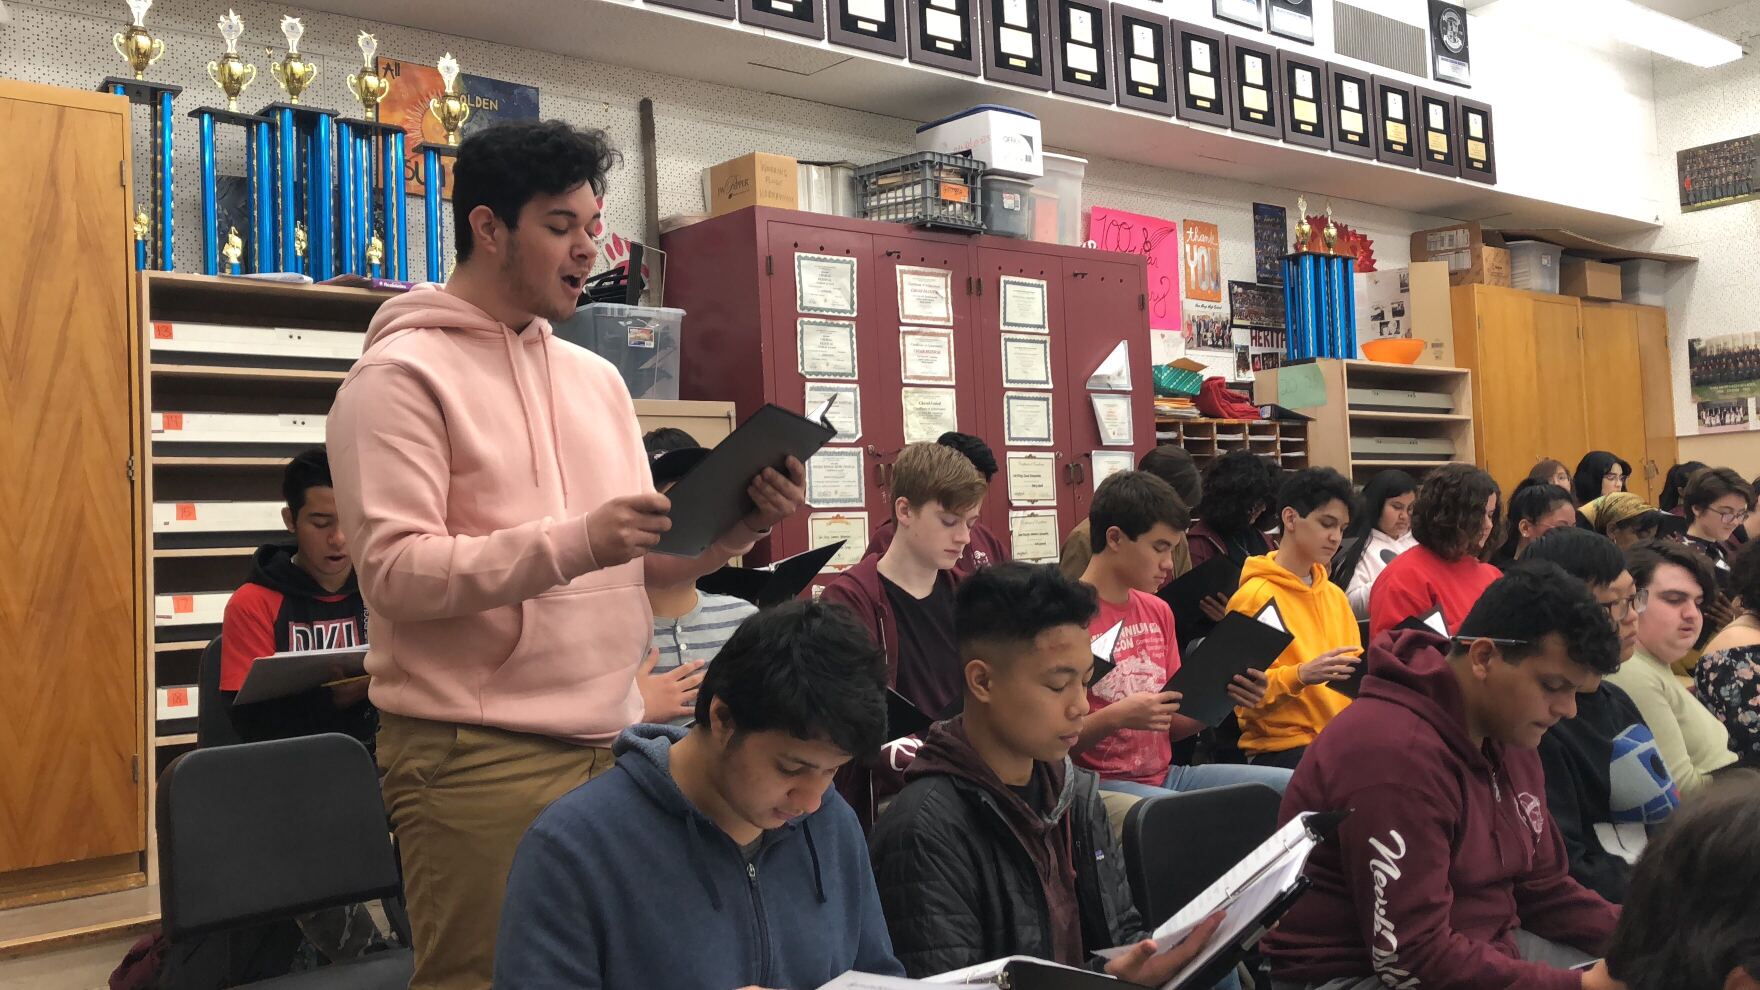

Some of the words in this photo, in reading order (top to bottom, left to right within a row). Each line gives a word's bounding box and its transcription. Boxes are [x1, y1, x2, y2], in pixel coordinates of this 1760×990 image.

[382, 62, 401, 80] All
[459, 94, 499, 111] OLDEN
[1185, 243, 1221, 292] YOU
